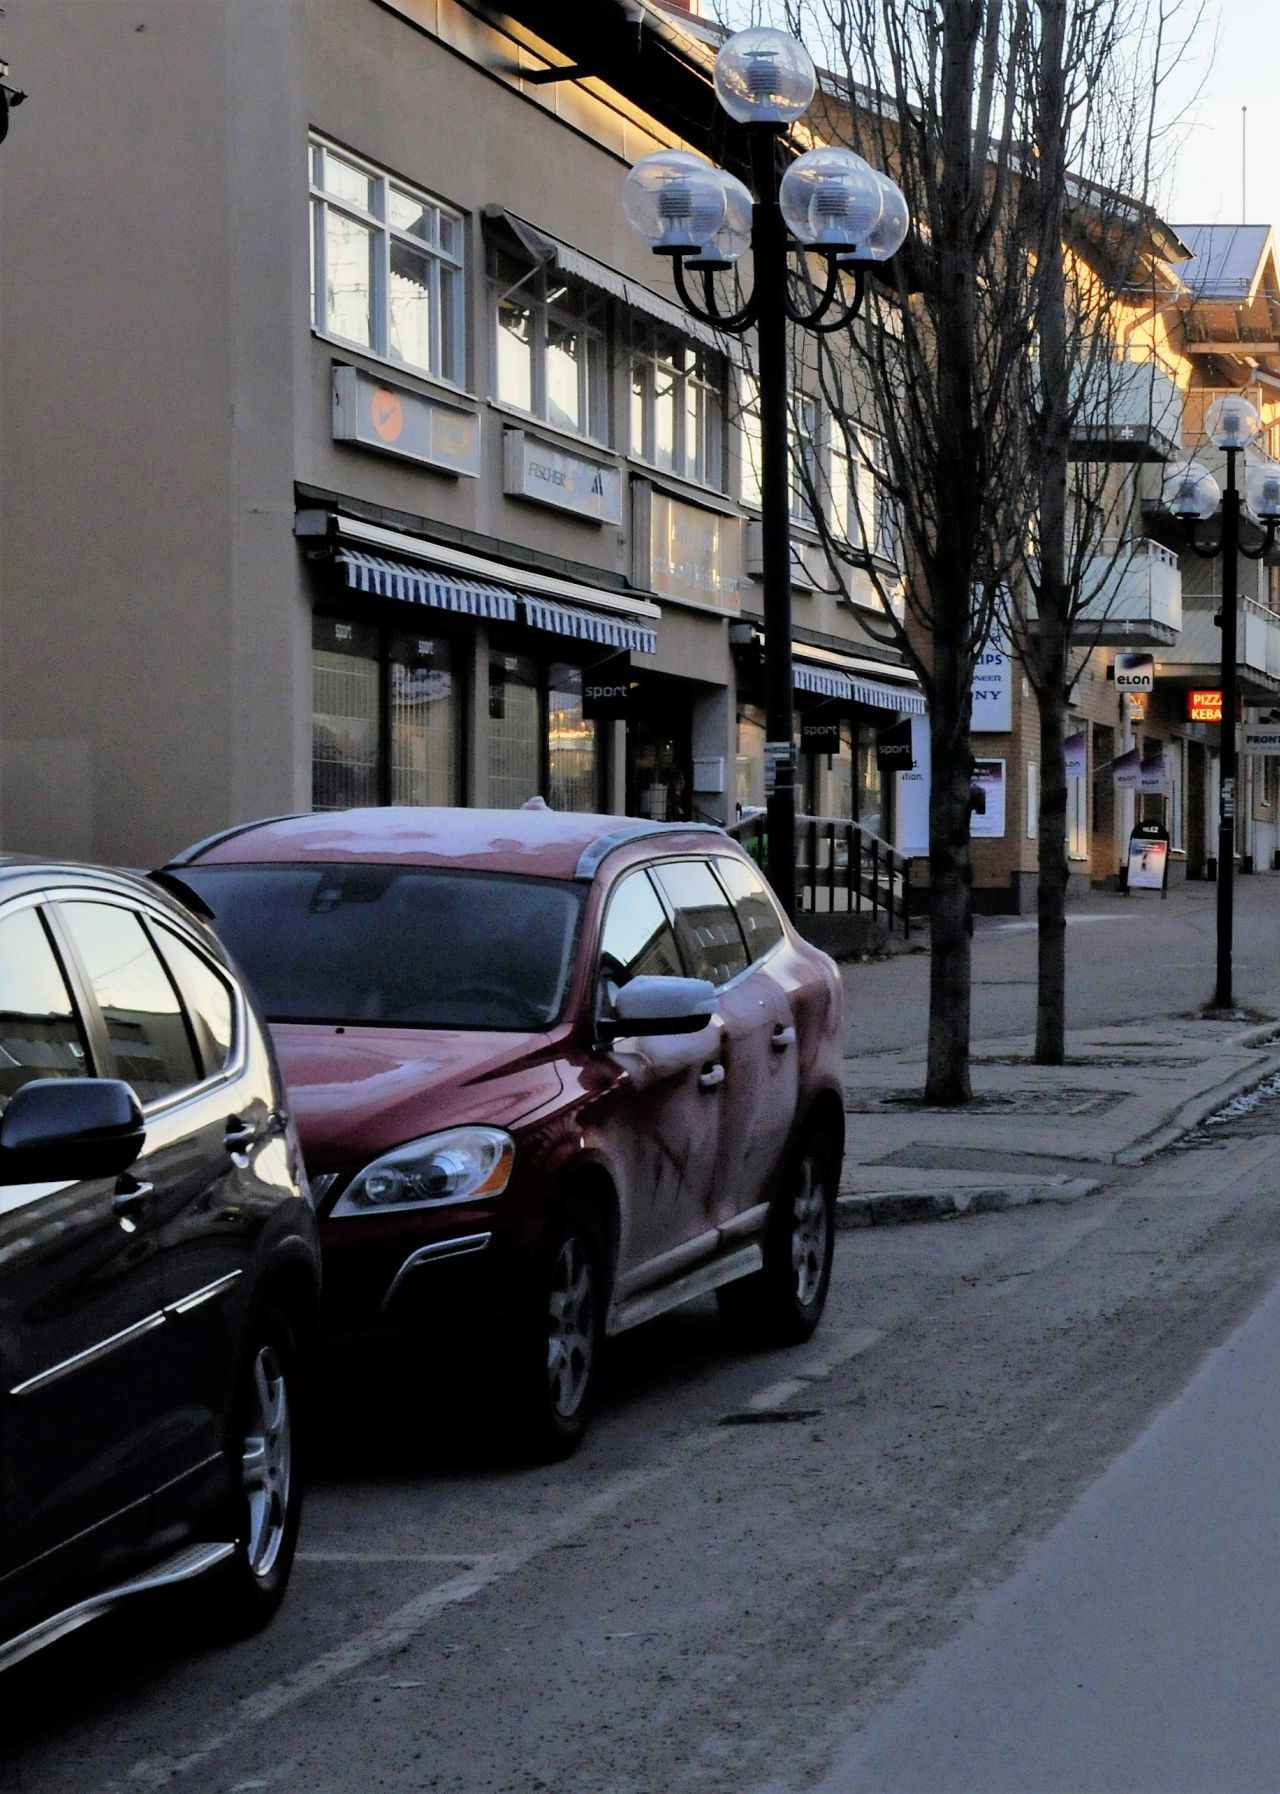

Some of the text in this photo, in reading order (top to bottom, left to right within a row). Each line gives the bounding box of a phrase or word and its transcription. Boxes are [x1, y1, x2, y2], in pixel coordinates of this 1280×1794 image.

[585, 685, 627, 699] sport
[1193, 693, 1223, 706] PIZZ
[803, 725, 838, 736] sport
[879, 744, 910, 755] sport
